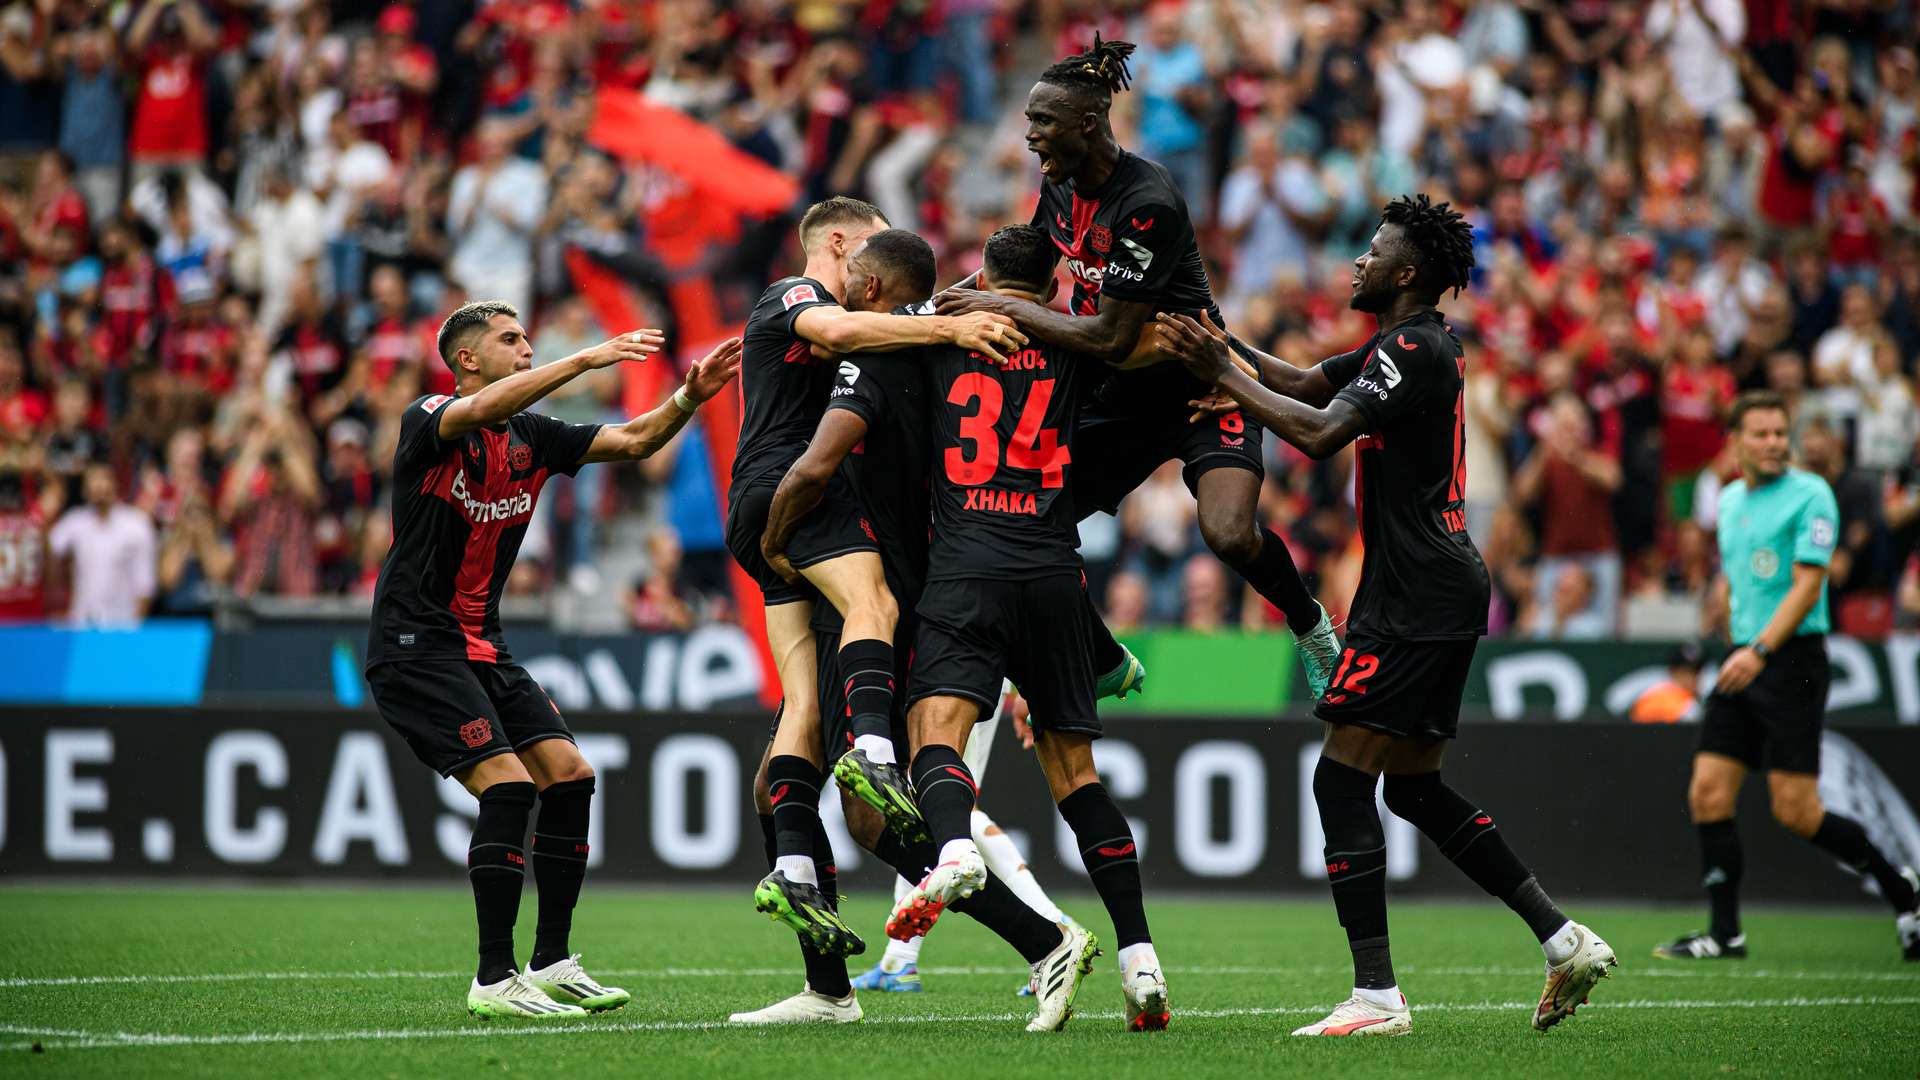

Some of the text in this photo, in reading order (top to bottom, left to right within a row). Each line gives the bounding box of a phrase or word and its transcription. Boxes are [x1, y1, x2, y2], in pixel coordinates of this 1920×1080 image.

[1109, 261, 1144, 282] trive
[830, 385, 855, 400] rive
[1356, 377, 1388, 401] trive
[944, 371, 1073, 490] 34
[451, 468, 532, 523] Barmenia
[963, 489, 1038, 516] XHAKA
[1331, 647, 1380, 695] 12
